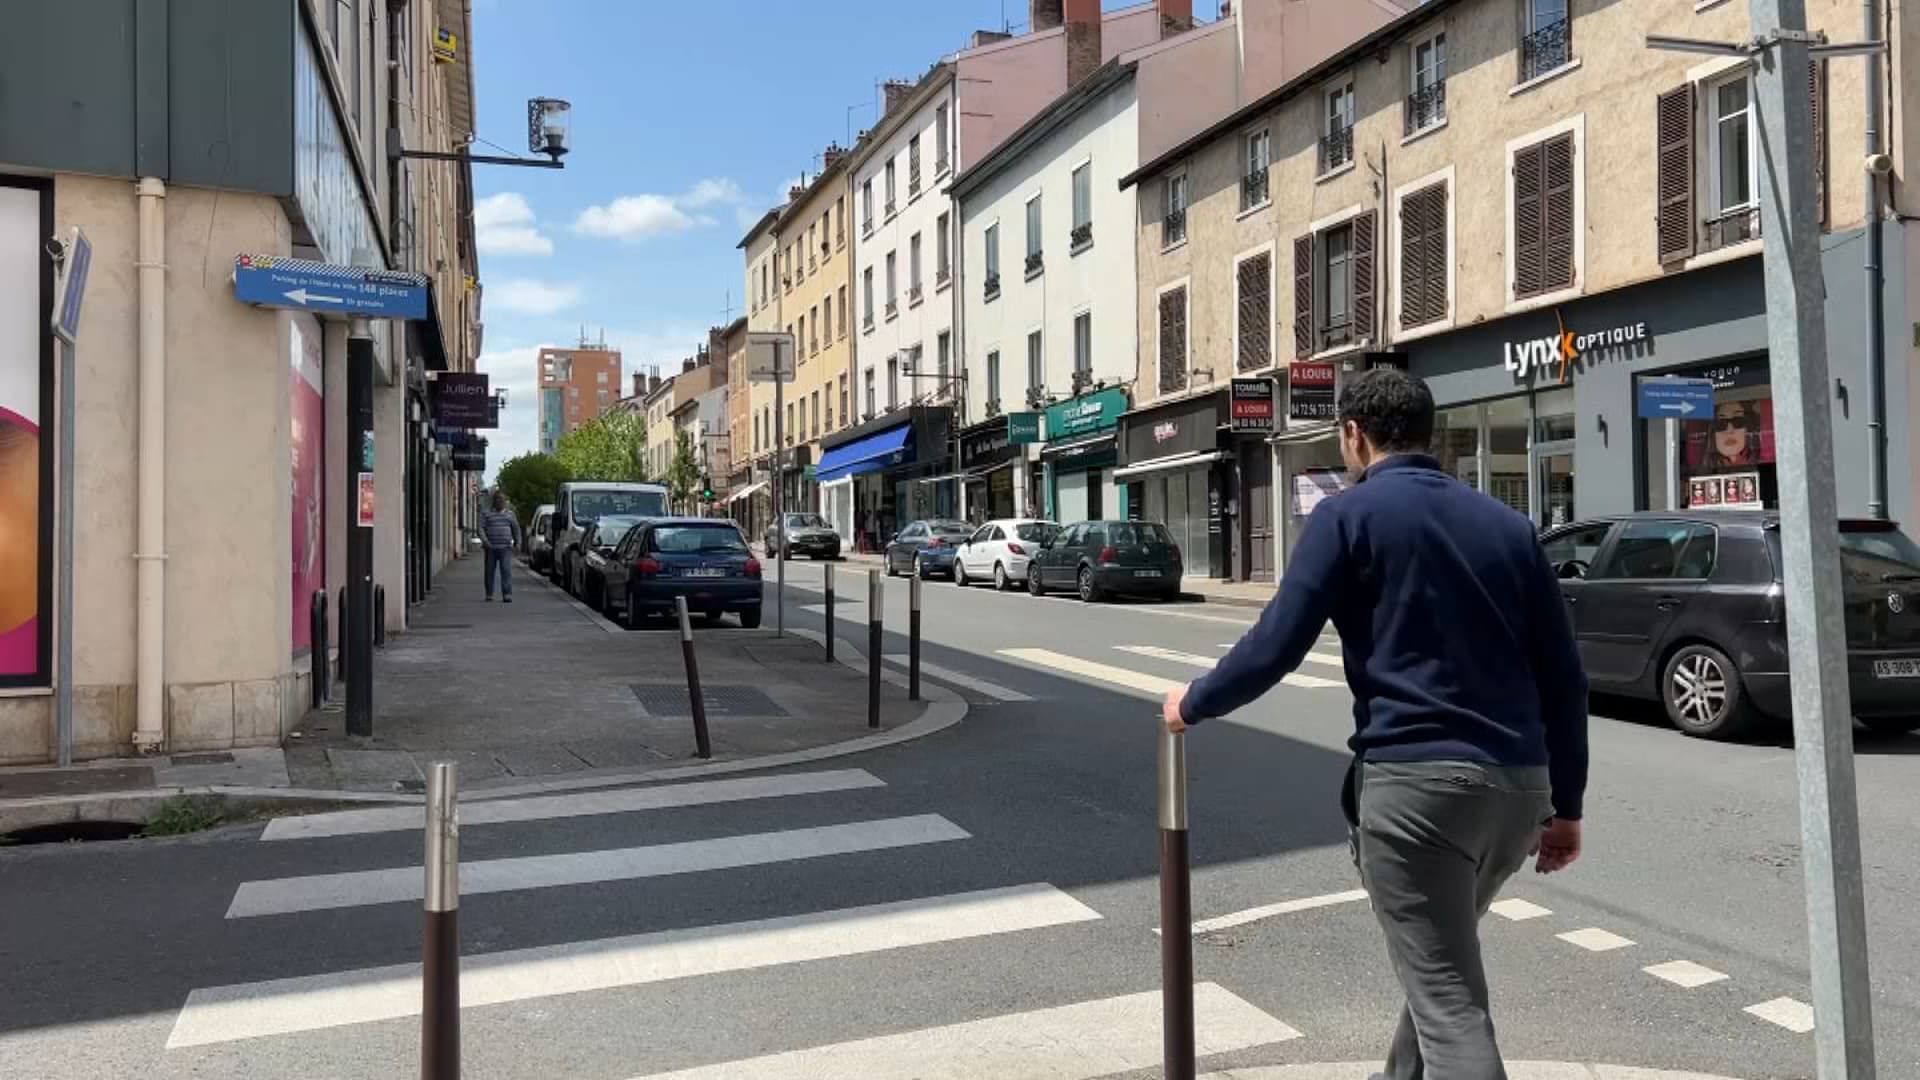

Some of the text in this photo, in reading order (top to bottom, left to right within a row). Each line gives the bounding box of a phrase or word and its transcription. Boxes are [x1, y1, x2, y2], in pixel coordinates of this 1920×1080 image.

[1576, 322, 1646, 350] OPTIQUE
[1292, 367, 1334, 380] A LOUER
[1703, 365, 1740, 380] vogue
[443, 383, 485, 396] Jullien
[1244, 403, 1268, 414] LOUER
